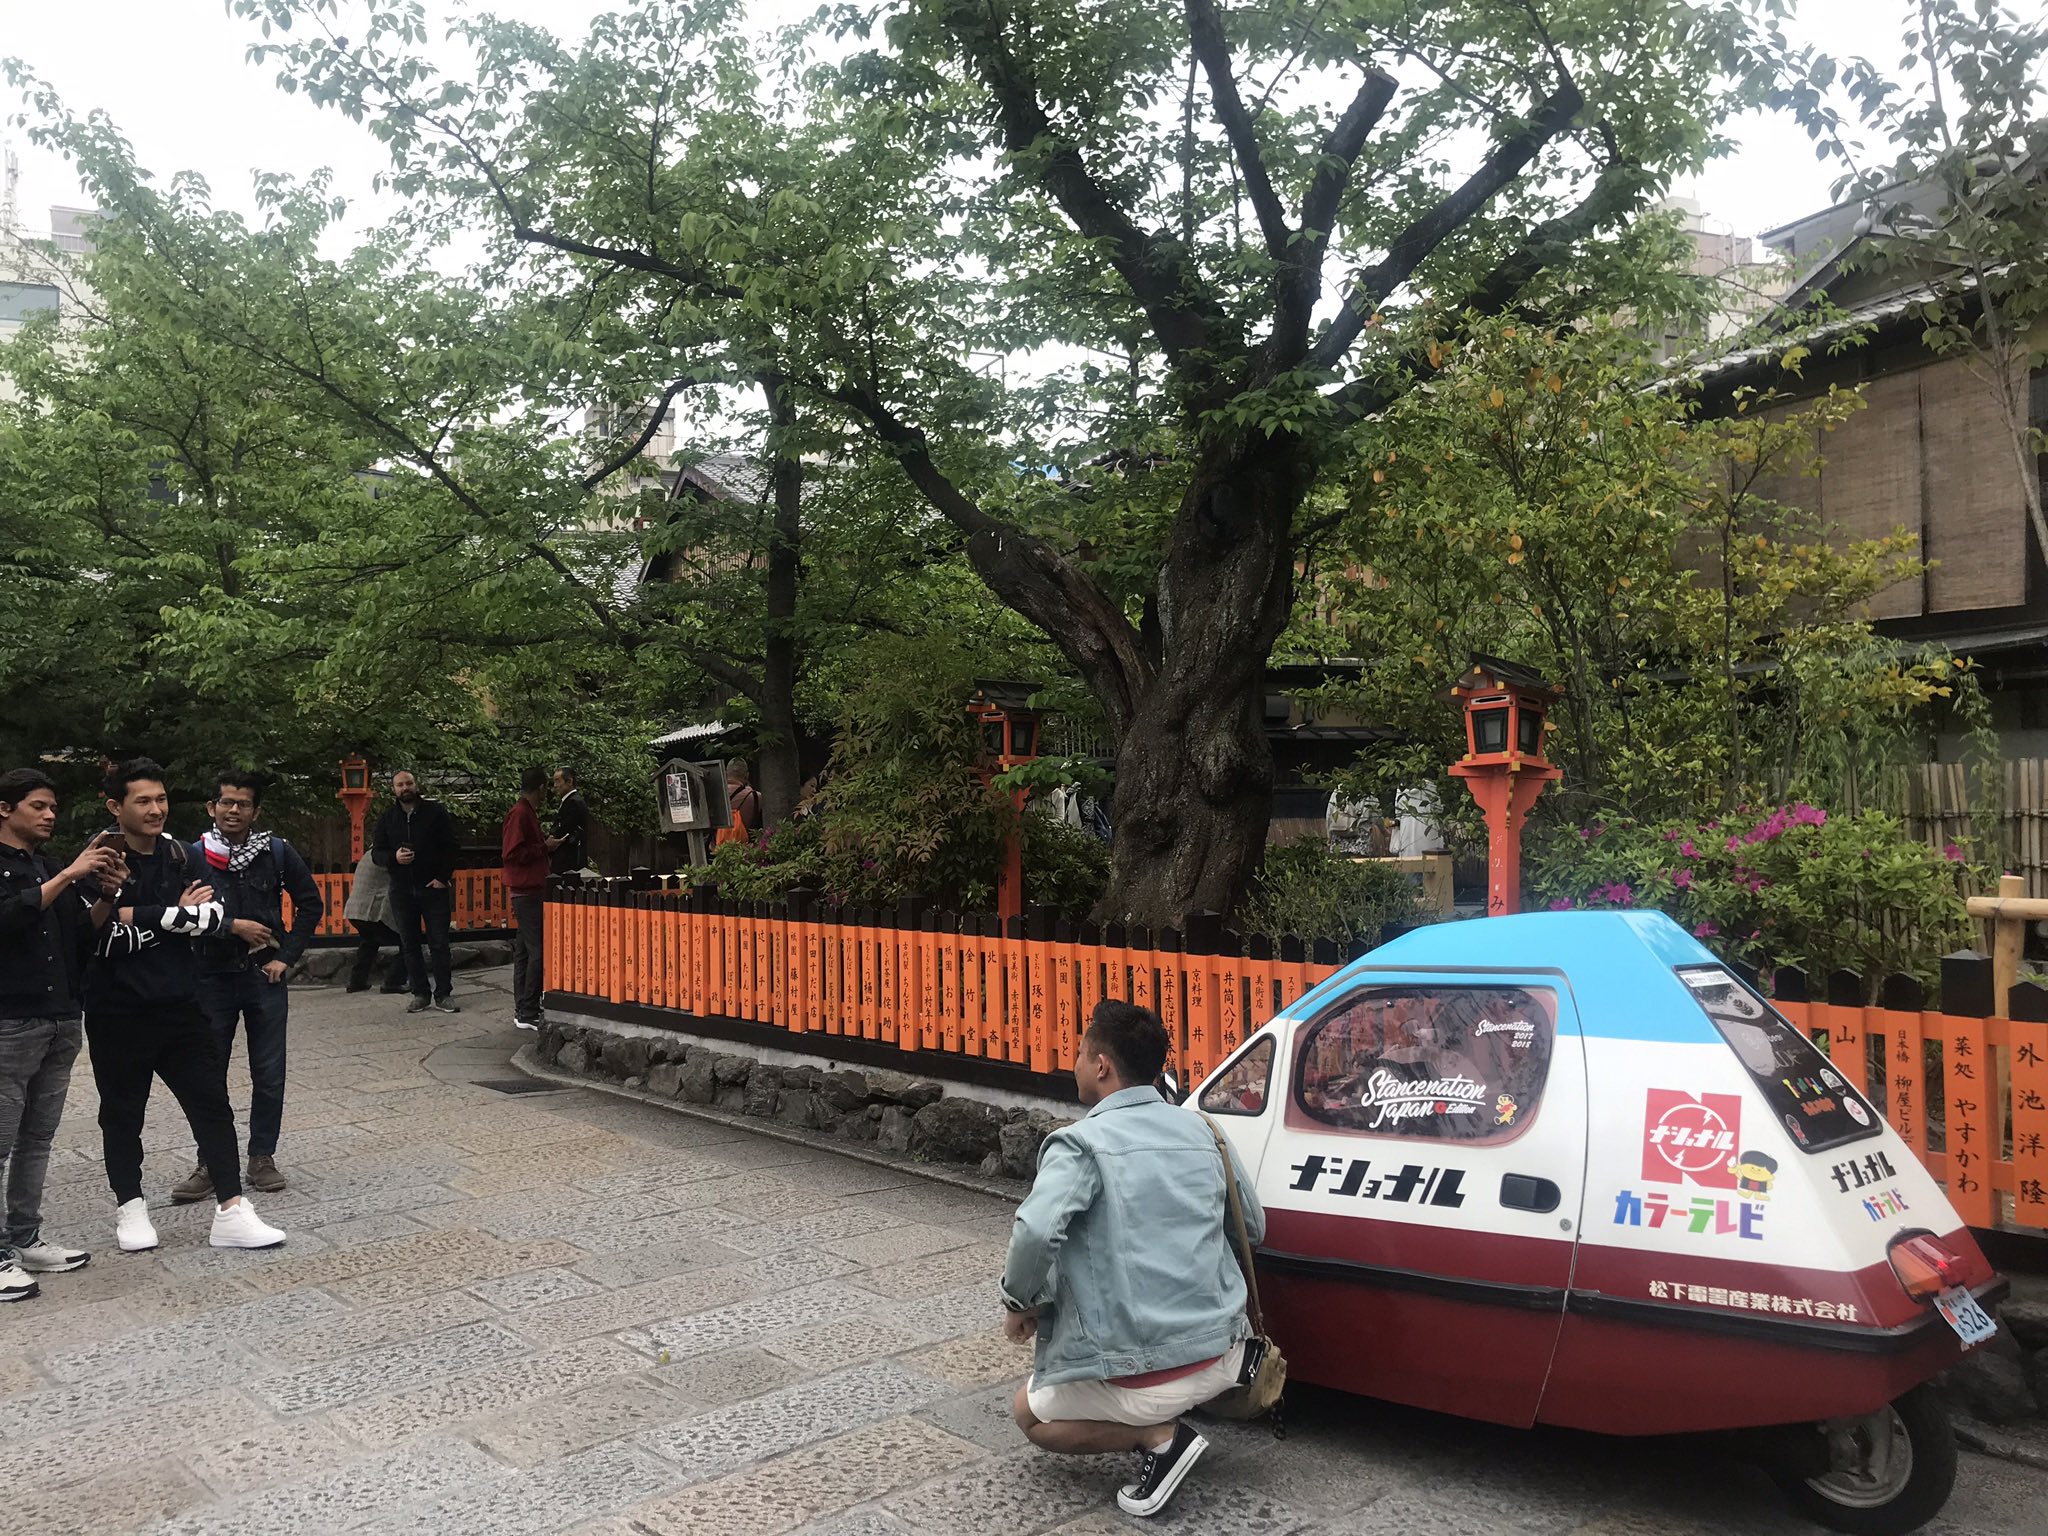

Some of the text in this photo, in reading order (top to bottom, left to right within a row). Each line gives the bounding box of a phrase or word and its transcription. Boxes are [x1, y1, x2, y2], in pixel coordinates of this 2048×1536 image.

[681, 922, 689, 1000] てっさい堂
[809, 933, 818, 1018] 平田すだれ店
[1010, 951, 1018, 983] 古美術
[1110, 959, 1119, 993] 古美術
[742, 962, 750, 1008] たんと
[790, 967, 799, 1016] 藤村屋
[944, 945, 955, 1039] 祇園 おかだ
[965, 946, 976, 1042] 金竹堂
[987, 950, 1000, 1047] 北斎
[1058, 954, 1070, 1058] 祇園 かわもと
[1135, 962, 1149, 1009] 八木
[1254, 974, 1265, 1010] 美術店
[1034, 1025, 1042, 1053] 白川店
[1190, 967, 1205, 1079] 京料理 井筒
[1475, 1019, 1535, 1037] Stancenation
[1511, 1040, 1532, 1048] 2018
[1513, 1032, 1534, 1040] 2017
[1834, 1024, 1857, 1046] 山
[1895, 1029, 1910, 1065] 日本橋
[1361, 1069, 1487, 1107] Stancenation
[1369, 1100, 1434, 1129] Japan
[1445, 1103, 1477, 1115] Edition
[1953, 1035, 1980, 1194] 菜処 やすかわ
[2016, 1041, 2048, 1206] 外池洋隆
[1649, 1124, 1735, 1151] ナショナル
[1289, 1154, 1467, 1209] ナショナル
[1831, 1150, 1897, 1194] ナショナル
[1612, 1189, 1765, 1241] カラーテレビ
[1957, 1303, 1990, 1335] 526
